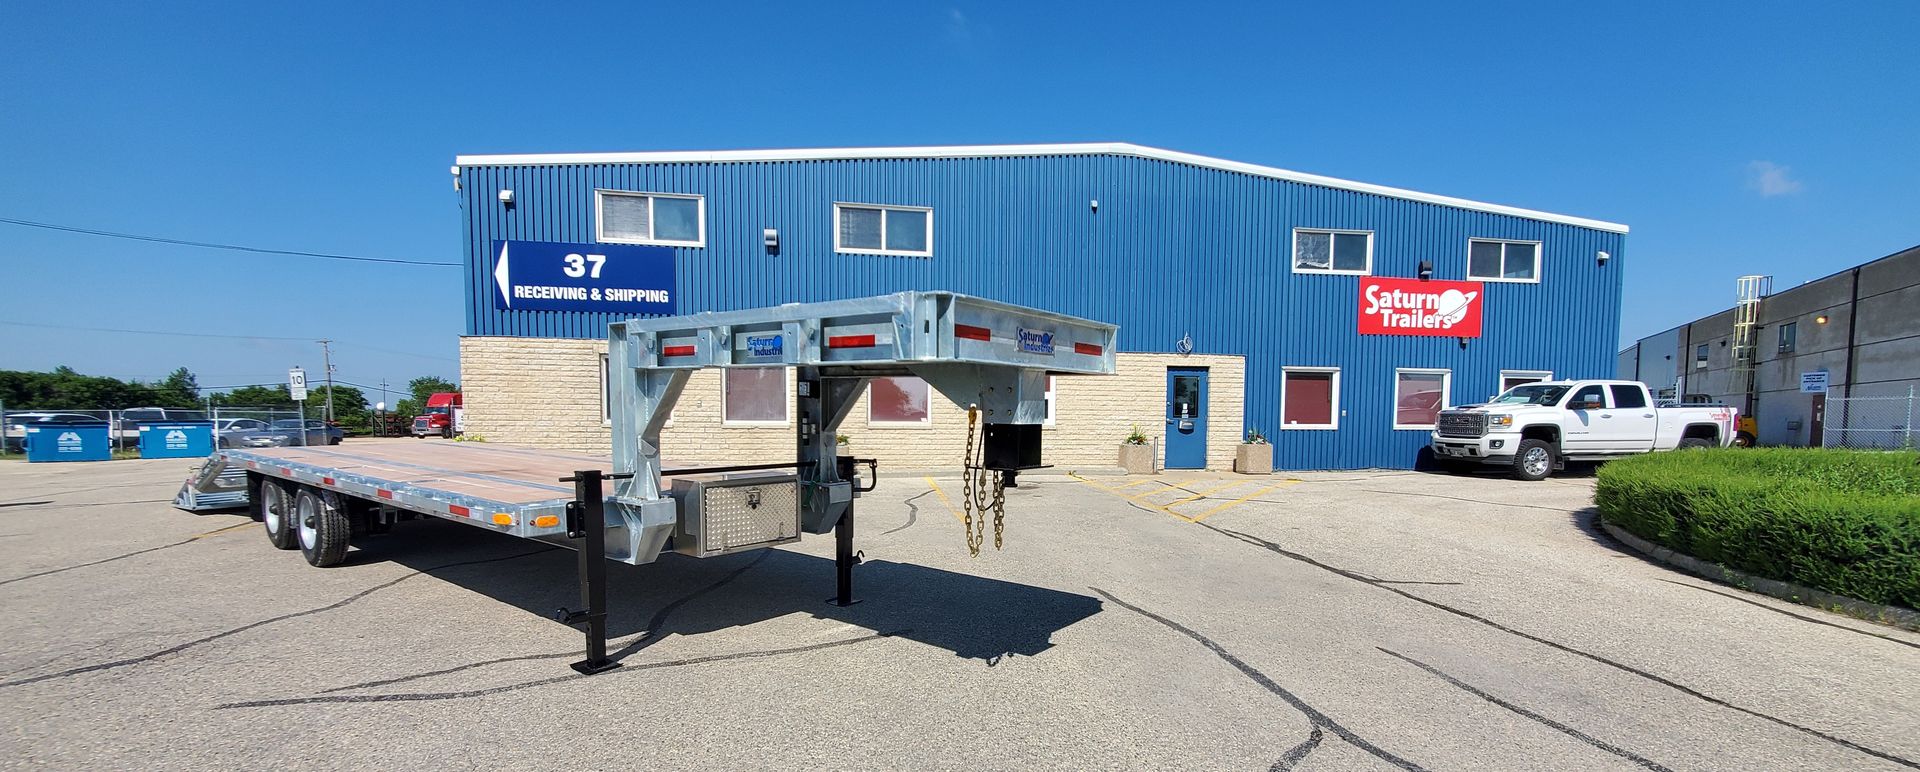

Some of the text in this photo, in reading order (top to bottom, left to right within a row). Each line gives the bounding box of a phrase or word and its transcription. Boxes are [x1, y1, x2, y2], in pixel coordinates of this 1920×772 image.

[563, 253, 606, 279] 37
[514, 285, 669, 303] RECEIVING & SHIPPING
[1365, 284, 1440, 315] Saturn
[1380, 309, 1453, 329] Trailers
[1018, 329, 1043, 342] Saturn
[754, 347, 783, 356] Industri
[292, 375, 303, 385] 10
